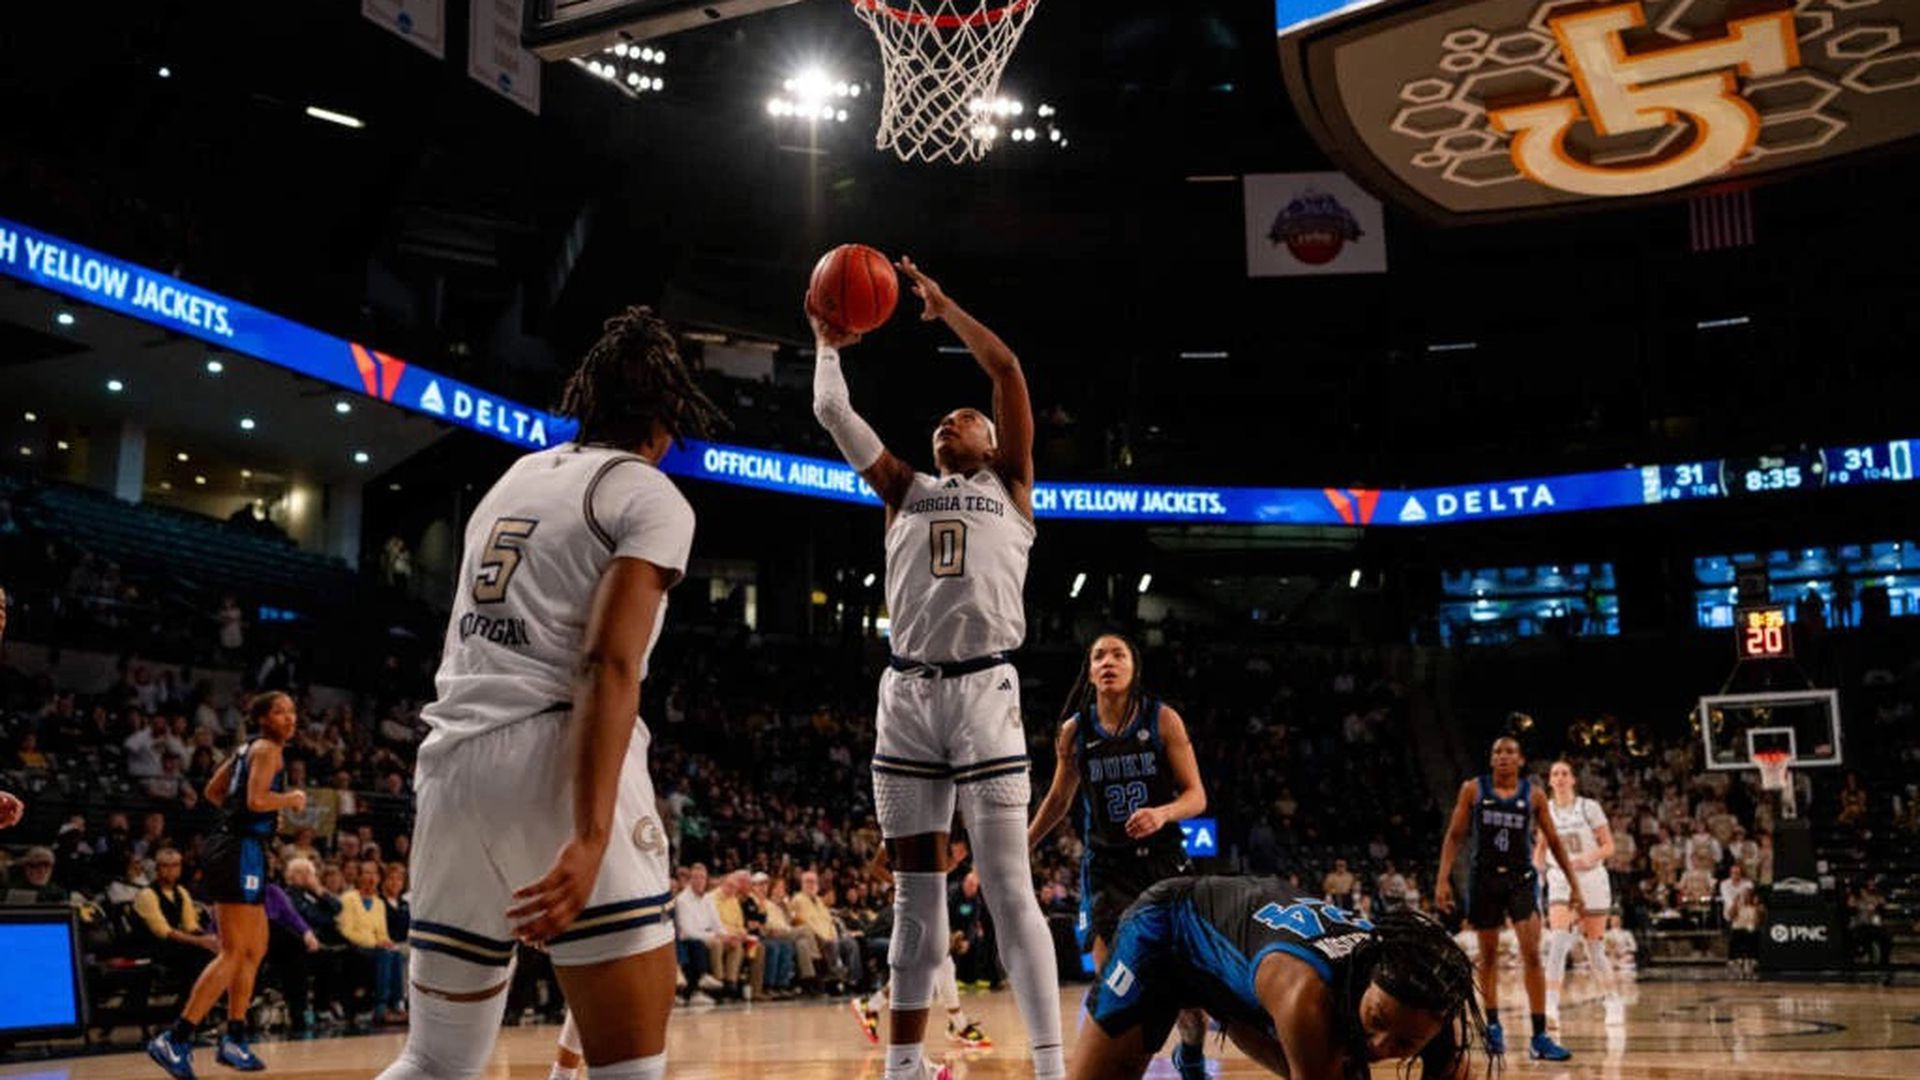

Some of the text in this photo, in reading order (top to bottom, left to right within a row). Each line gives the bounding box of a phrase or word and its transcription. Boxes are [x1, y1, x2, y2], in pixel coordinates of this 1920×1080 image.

[25, 236, 129, 299] YELLOW
[132, 276, 234, 337] JACKETS.
[453, 390, 547, 446] DELTA
[703, 448, 783, 482] OFFICIAL
[788, 462, 856, 493] AIRLINE
[1844, 446, 1874, 470] 31
[1675, 463, 1703, 486] 31
[1746, 466, 1801, 491] 8:35
[1061, 489, 1138, 513] YELLOW
[1141, 491, 1227, 515] JACKETS.
[1436, 483, 1555, 517] DELTA
[472, 518, 540, 604] 5
[930, 519, 967, 578] 0
[1747, 627, 1783, 653] 20
[1088, 752, 1157, 782] DUKE
[1105, 780, 1149, 823] 22
[1482, 810, 1525, 829] DUKE
[1494, 828, 1510, 852] 4
[1790, 925, 1828, 941] PNC
